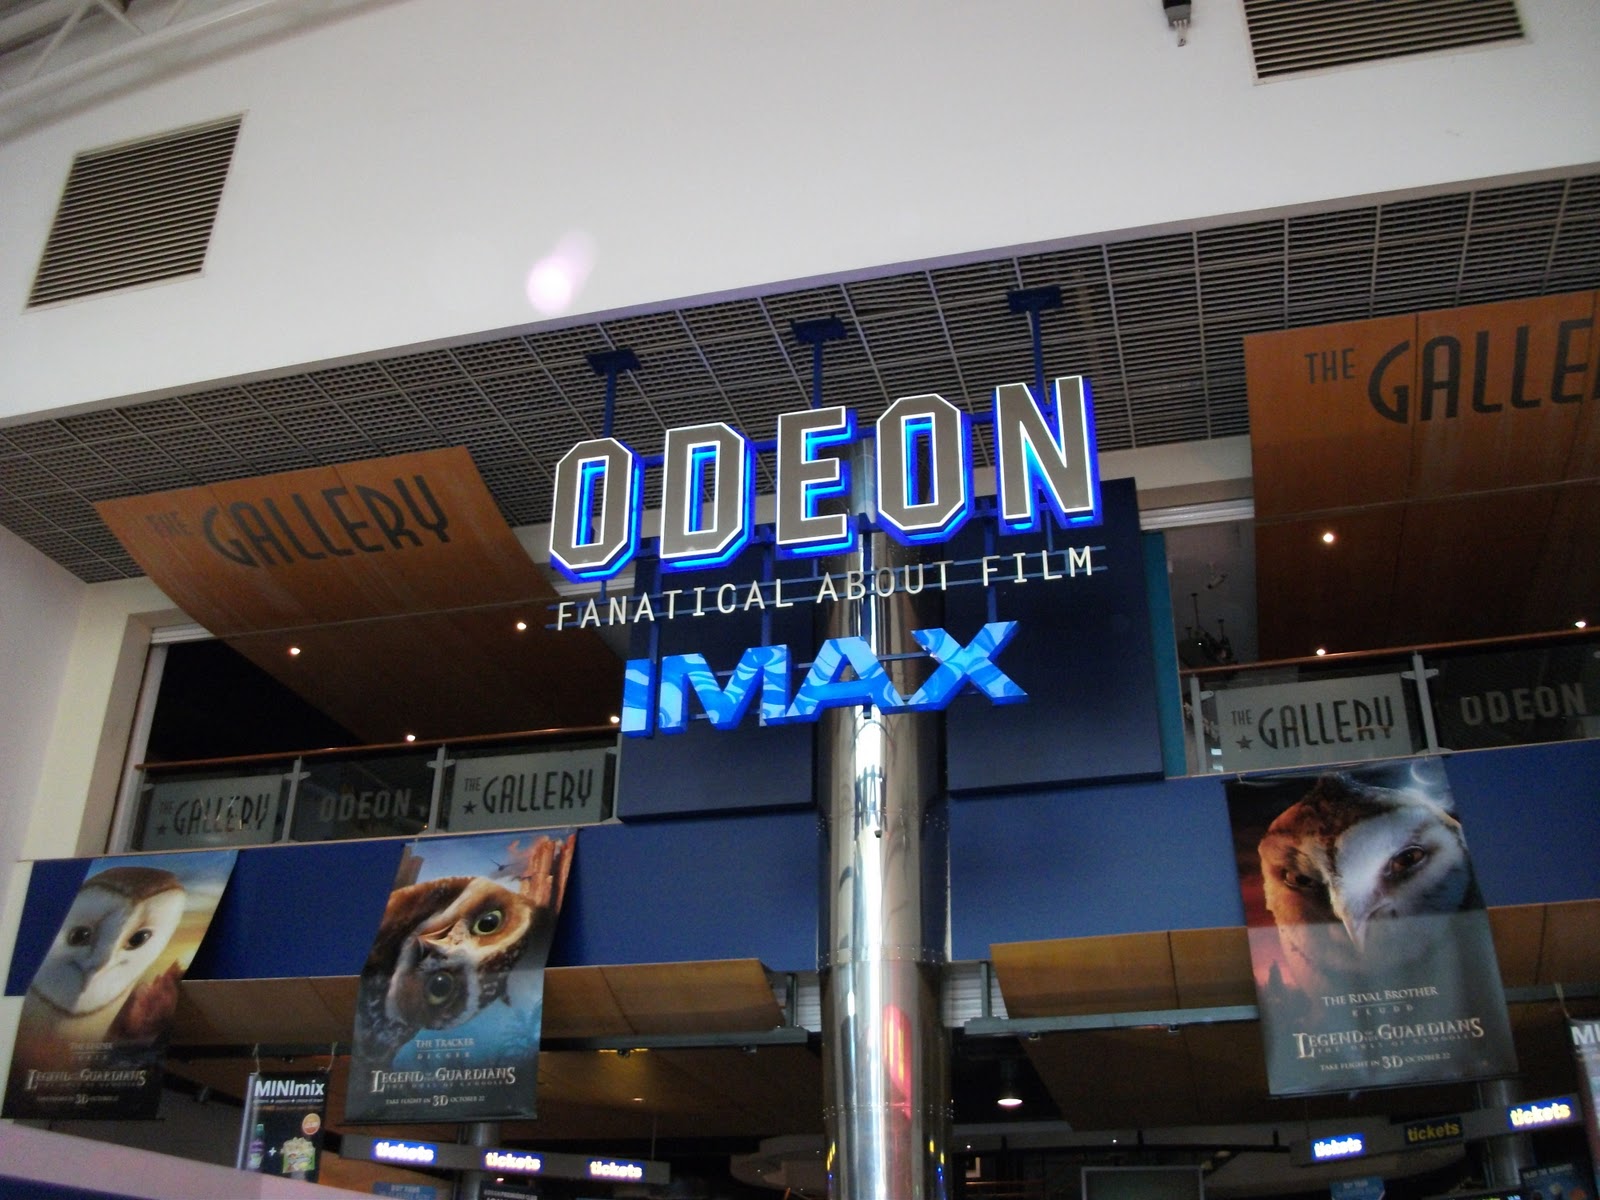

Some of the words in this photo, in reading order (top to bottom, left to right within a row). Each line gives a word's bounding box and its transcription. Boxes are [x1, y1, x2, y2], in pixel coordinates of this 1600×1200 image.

[1305, 347, 1355, 384] THE
[1368, 318, 1600, 424] GALLE
[549, 375, 1100, 582] ODEON
[146, 509, 195, 537] THE
[202, 475, 450, 568] GALLERY
[557, 580, 794, 630] FANATICAL
[816, 559, 953, 604] ABOUT
[981, 545, 1093, 586] FILM
[621, 620, 1028, 737] IMAX
[1460, 682, 1588, 726] ODEON
[1231, 708, 1253, 725] THE
[1258, 696, 1395, 750] GALLERY
[464, 777, 482, 792] THE
[482, 768, 594, 814] GALLERY
[174, 793, 271, 836] GALLERY
[319, 787, 412, 823] ODEON
[1321, 995, 1346, 1007] THE
[1348, 991, 1381, 1004] RIVAL
[1384, 986, 1440, 1000] BROTHER
[415, 1039, 433, 1049] THE
[1292, 1029, 1364, 1060] LEGEND
[1378, 1017, 1485, 1041] GUARDIANS
[1382, 1055, 1404, 1070] 3D
[1404, 1053, 1439, 1064] OCTOBER
[254, 1079, 326, 1097] MINImix
[371, 1069, 424, 1093] LEGEND
[435, 1066, 516, 1085] GUARDIANS
[432, 1094, 449, 1107] 3D
[1510, 1103, 1572, 1127] tickets
[1407, 1121, 1461, 1142] tickets
[375, 1141, 435, 1162] tickets
[1314, 1137, 1363, 1157] tickets
[485, 1152, 542, 1170] tickets
[589, 1161, 643, 1178] tickets
